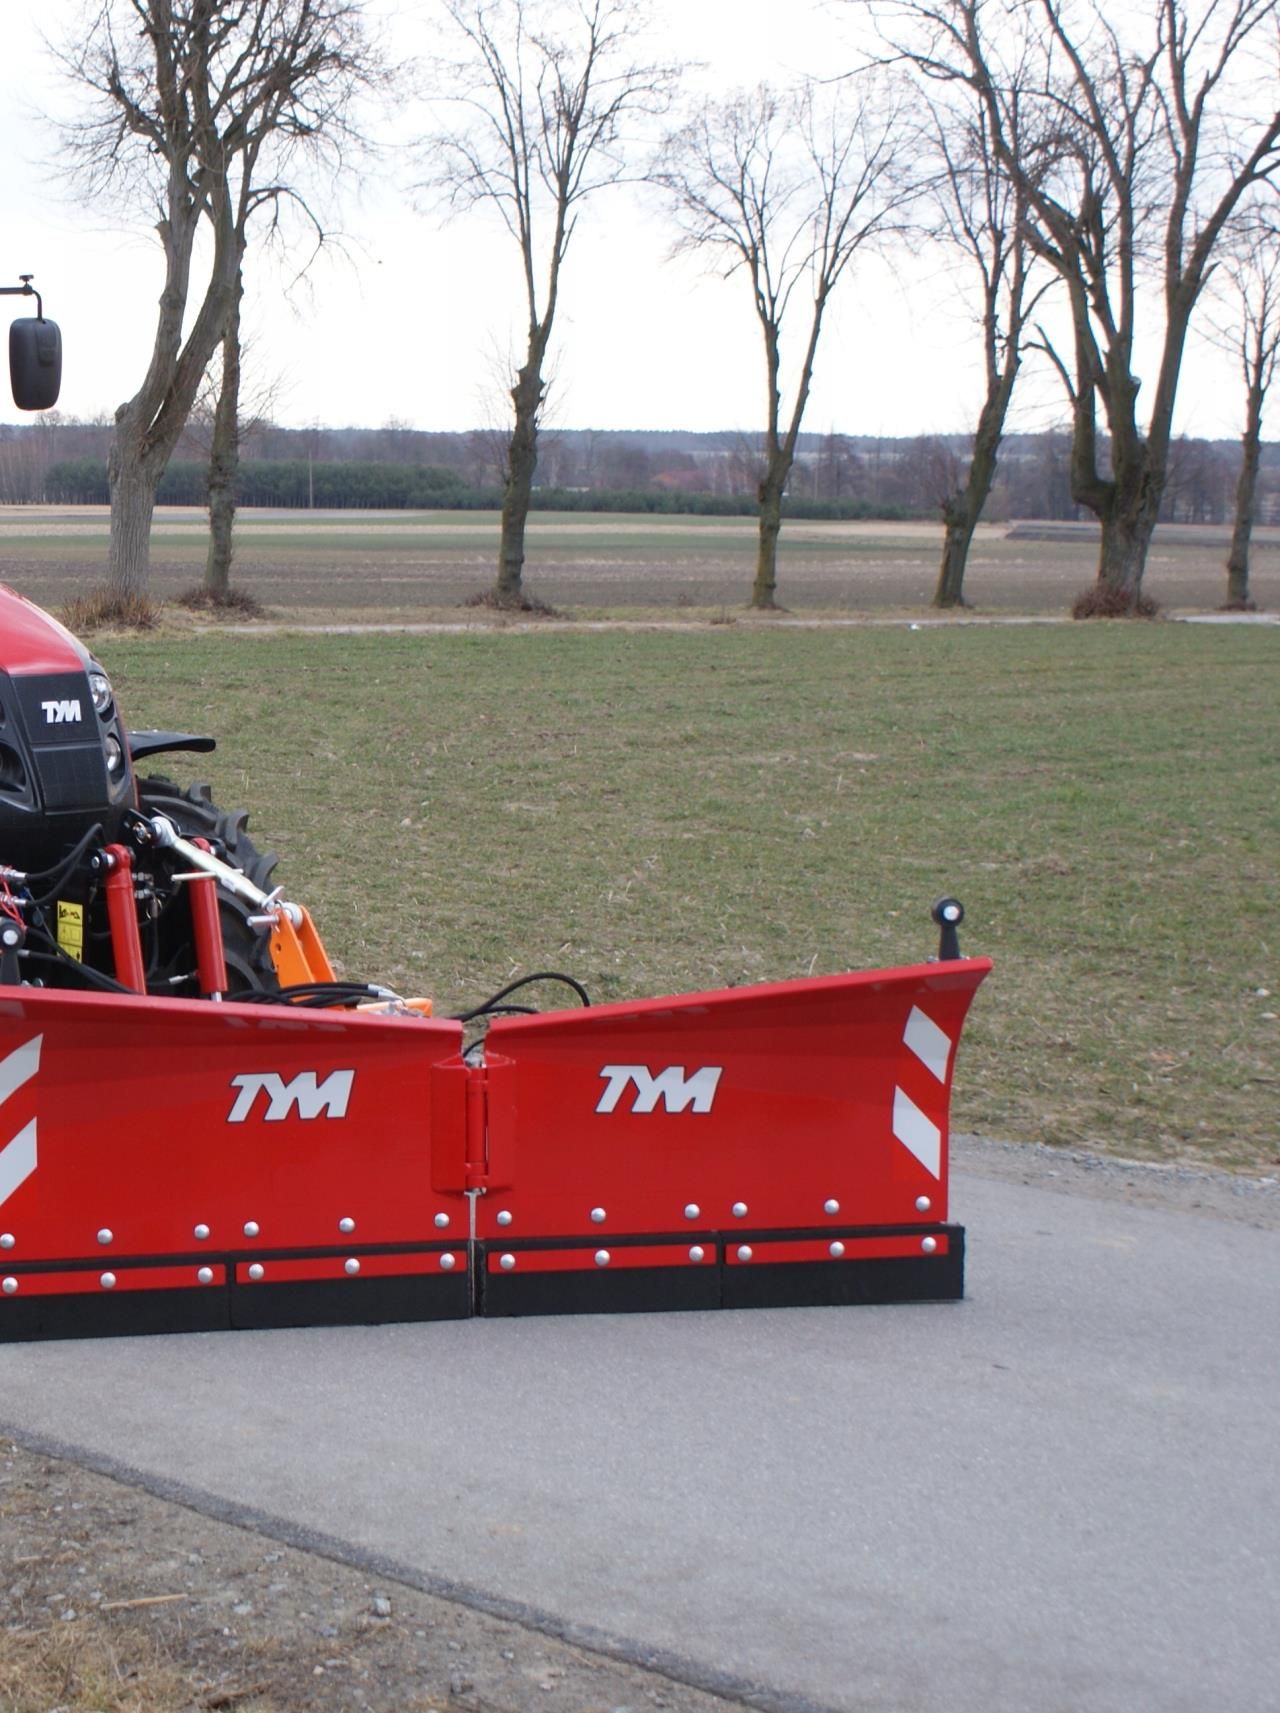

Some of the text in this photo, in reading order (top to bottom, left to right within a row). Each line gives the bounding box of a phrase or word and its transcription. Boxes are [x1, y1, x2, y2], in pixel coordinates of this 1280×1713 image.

[41, 699, 82, 724] TYM
[226, 1068, 356, 1123] TYM
[594, 1064, 724, 1114] TYM
